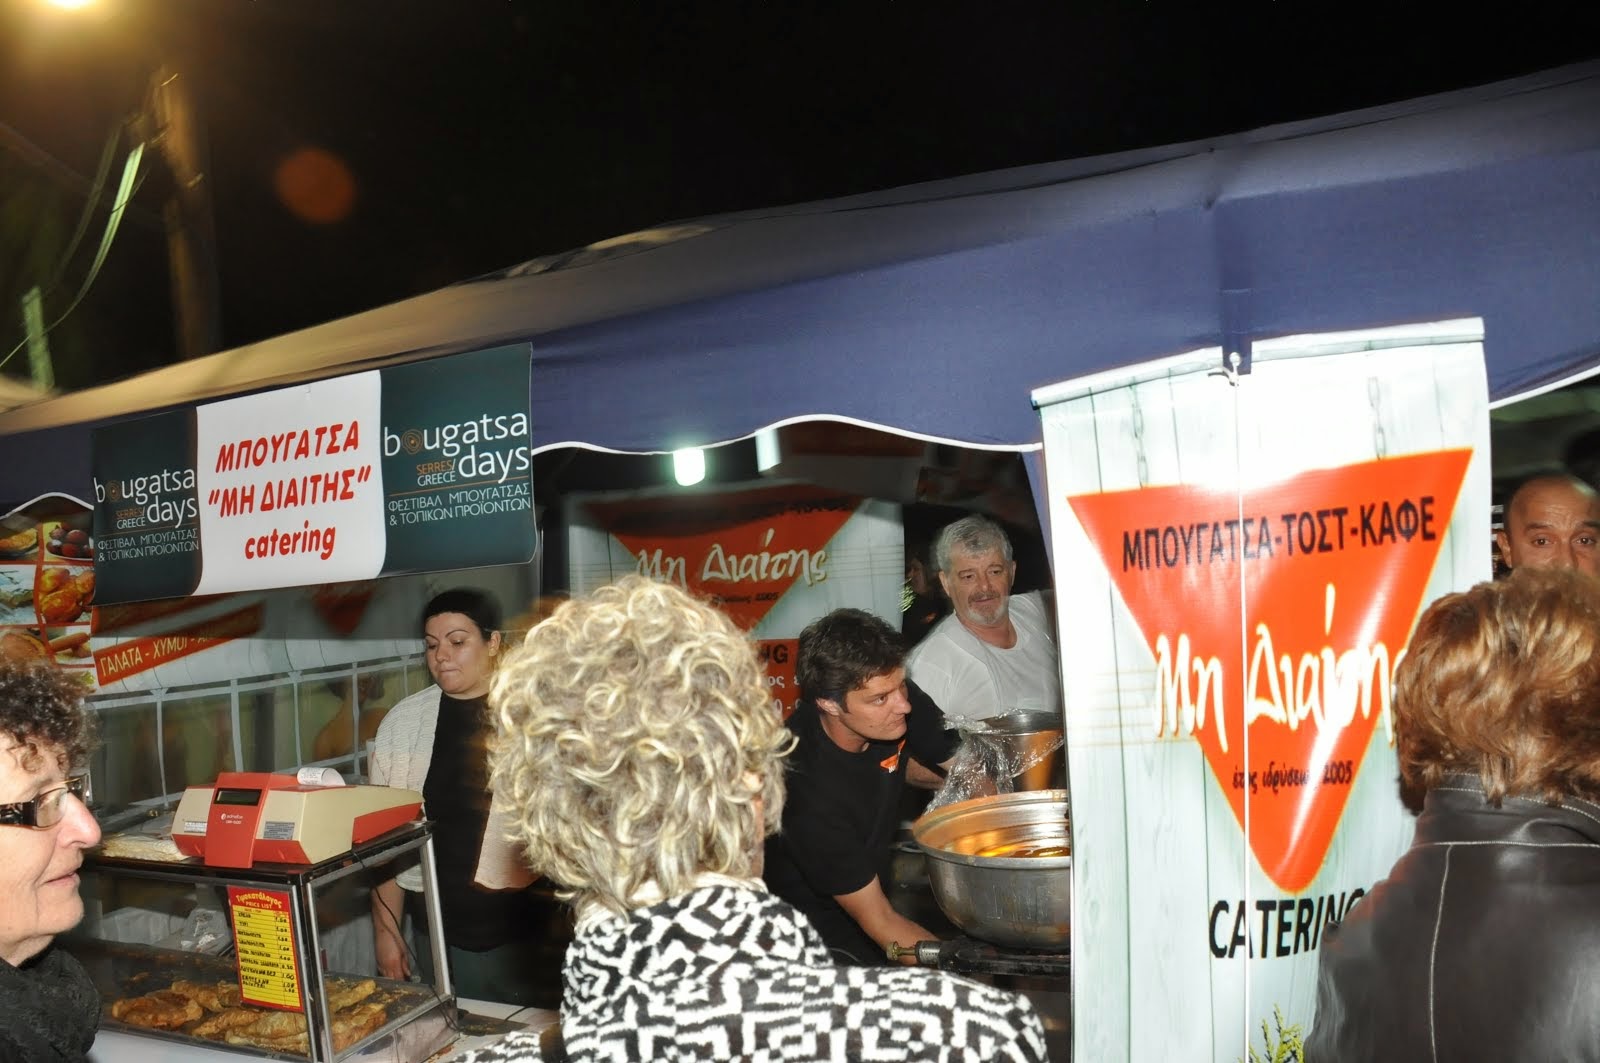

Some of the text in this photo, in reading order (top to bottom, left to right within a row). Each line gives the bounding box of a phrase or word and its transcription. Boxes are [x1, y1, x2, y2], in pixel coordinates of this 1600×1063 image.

[215, 420, 359, 473] ΜΠΟΥΓΑΤΣΑ
[384, 412, 528, 457] bougatsa
[417, 471, 456, 486] GREECE
[458, 445, 529, 484] days
[147, 495, 197, 528] days
[388, 482, 530, 512] ΦΕΣΤΙΒΑΛ ΜΠΟΥΓΑΤΣΑΣ
[389, 497, 531, 526] & ΤΟΠΙΚΩΝ ΠΡΟΪΟΝΤΩΝ
[117, 517, 145, 529] GREECE
[98, 528, 198, 550] ΦΕΣΤΙΒΑΛ ΜΠΟΥΓΑΤΣΑΣ
[107, 547, 144, 560] ΤΟΠΙΚΩΝ
[245, 519, 336, 560] catering
[100, 646, 143, 677] ΓΑΛΑΤΑ
[1154, 633, 1229, 754] Μη
